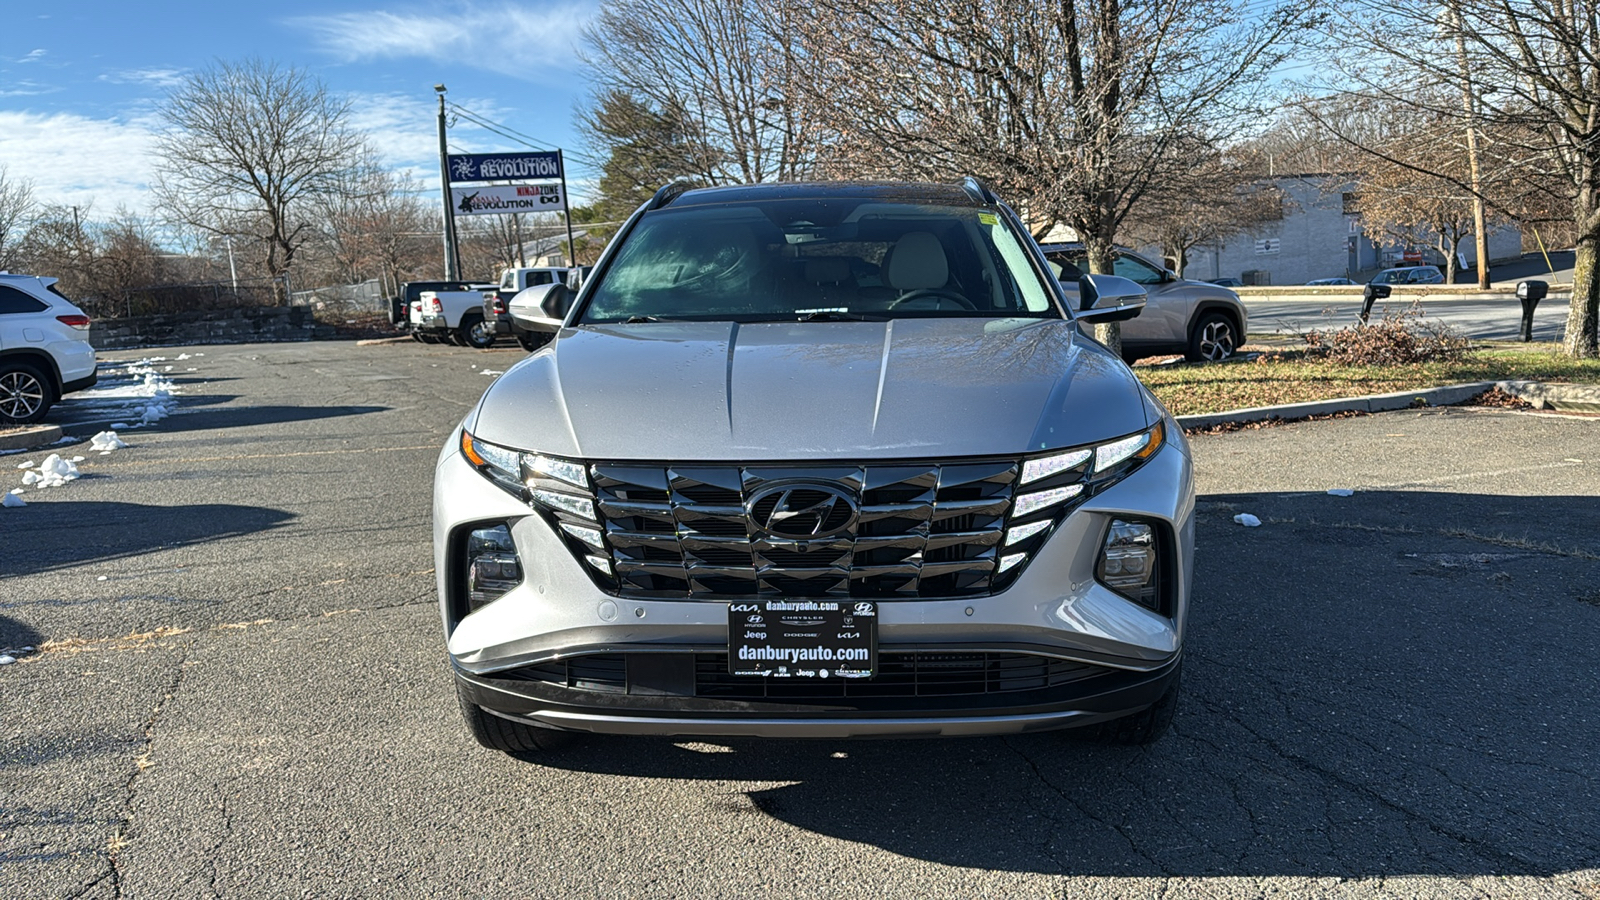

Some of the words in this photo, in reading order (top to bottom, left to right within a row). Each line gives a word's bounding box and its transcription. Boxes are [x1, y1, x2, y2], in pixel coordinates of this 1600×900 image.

[480, 162, 558, 178] REVOLUTION
[516, 185, 559, 196] NINJAZONE
[766, 600, 839, 612] danburyauto.com
[744, 630, 767, 640] Jeep
[738, 645, 868, 663] danburyauto.com
[796, 669, 815, 677] Jeep
